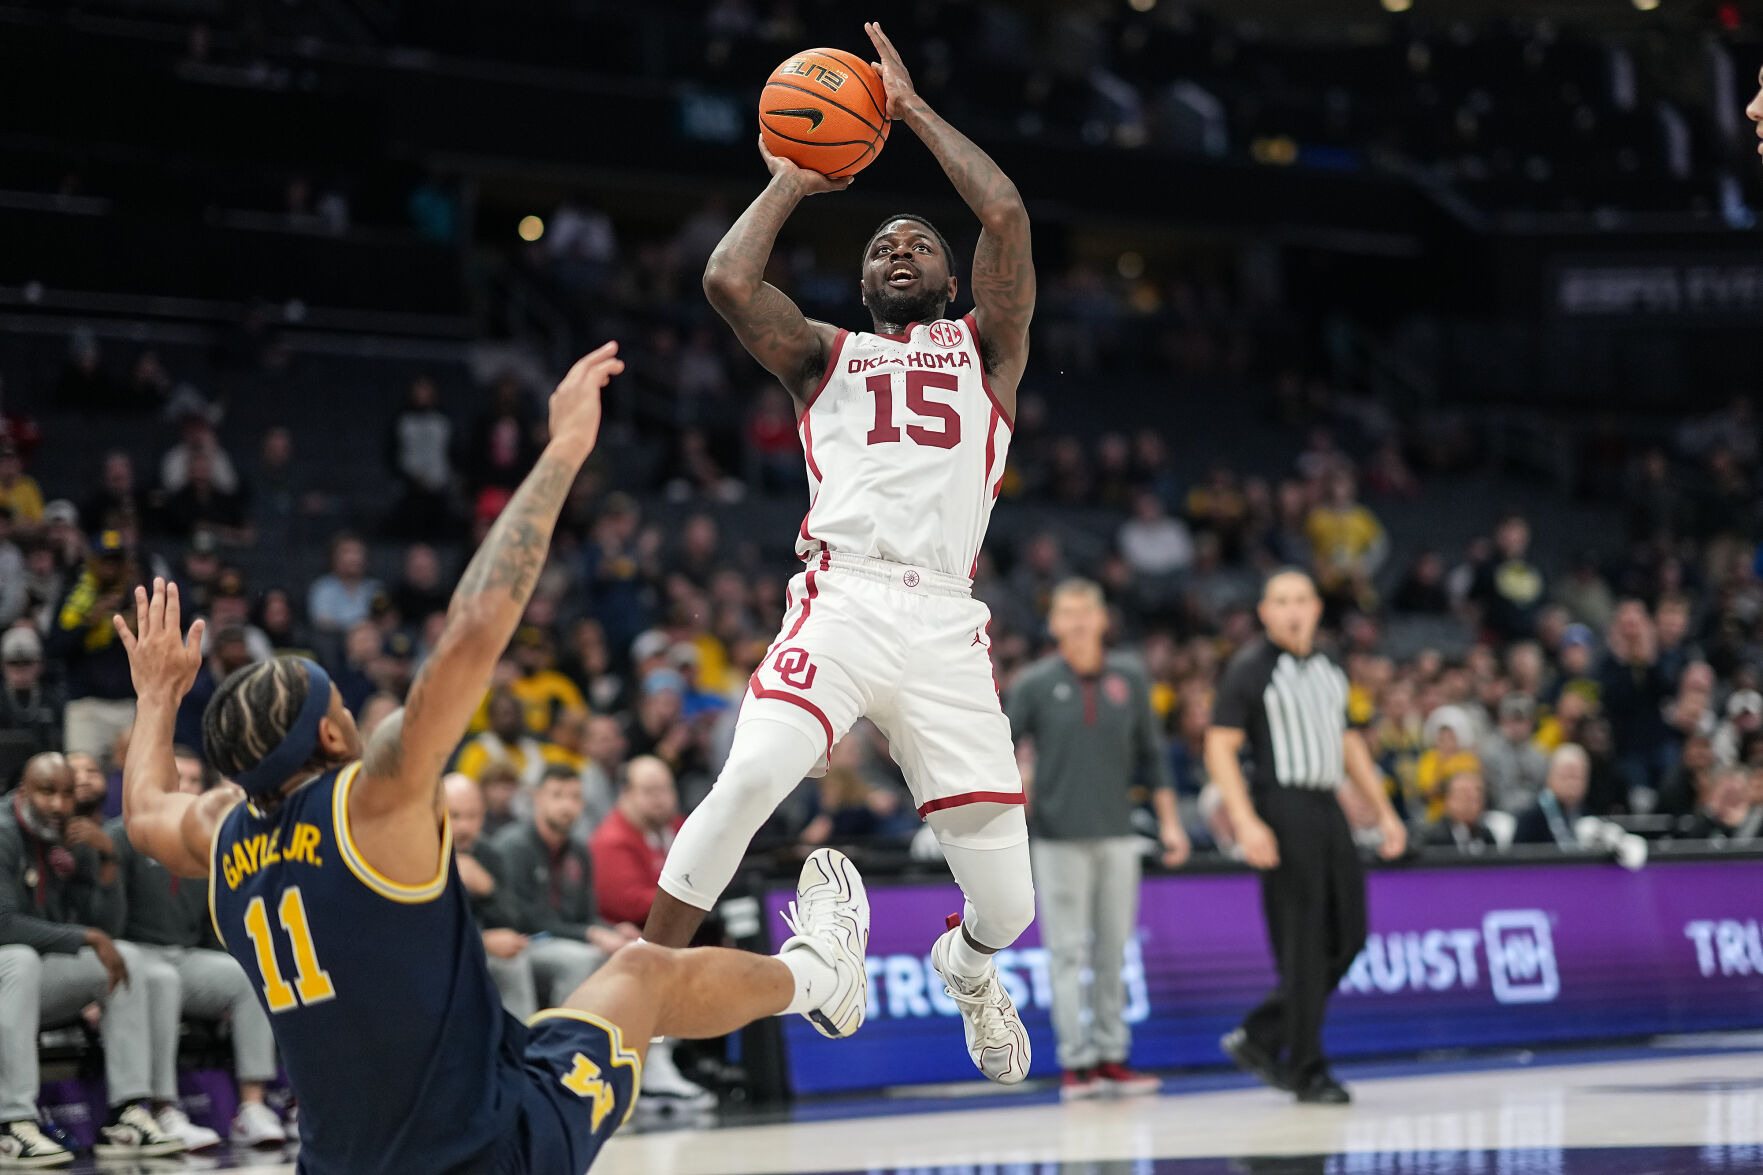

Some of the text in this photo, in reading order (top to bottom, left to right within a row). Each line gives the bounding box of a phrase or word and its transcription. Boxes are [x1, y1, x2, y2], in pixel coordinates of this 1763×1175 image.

[780, 60, 846, 93] ELITE
[848, 352, 972, 374] OKLAHOMA
[930, 321, 962, 347] SEC
[865, 370, 962, 450] 15
[773, 647, 817, 690] OU
[222, 822, 323, 890] GAYLE JR.
[243, 884, 336, 1015] 11
[1338, 928, 1481, 994] UIST
[866, 947, 1053, 1019] TRUST
